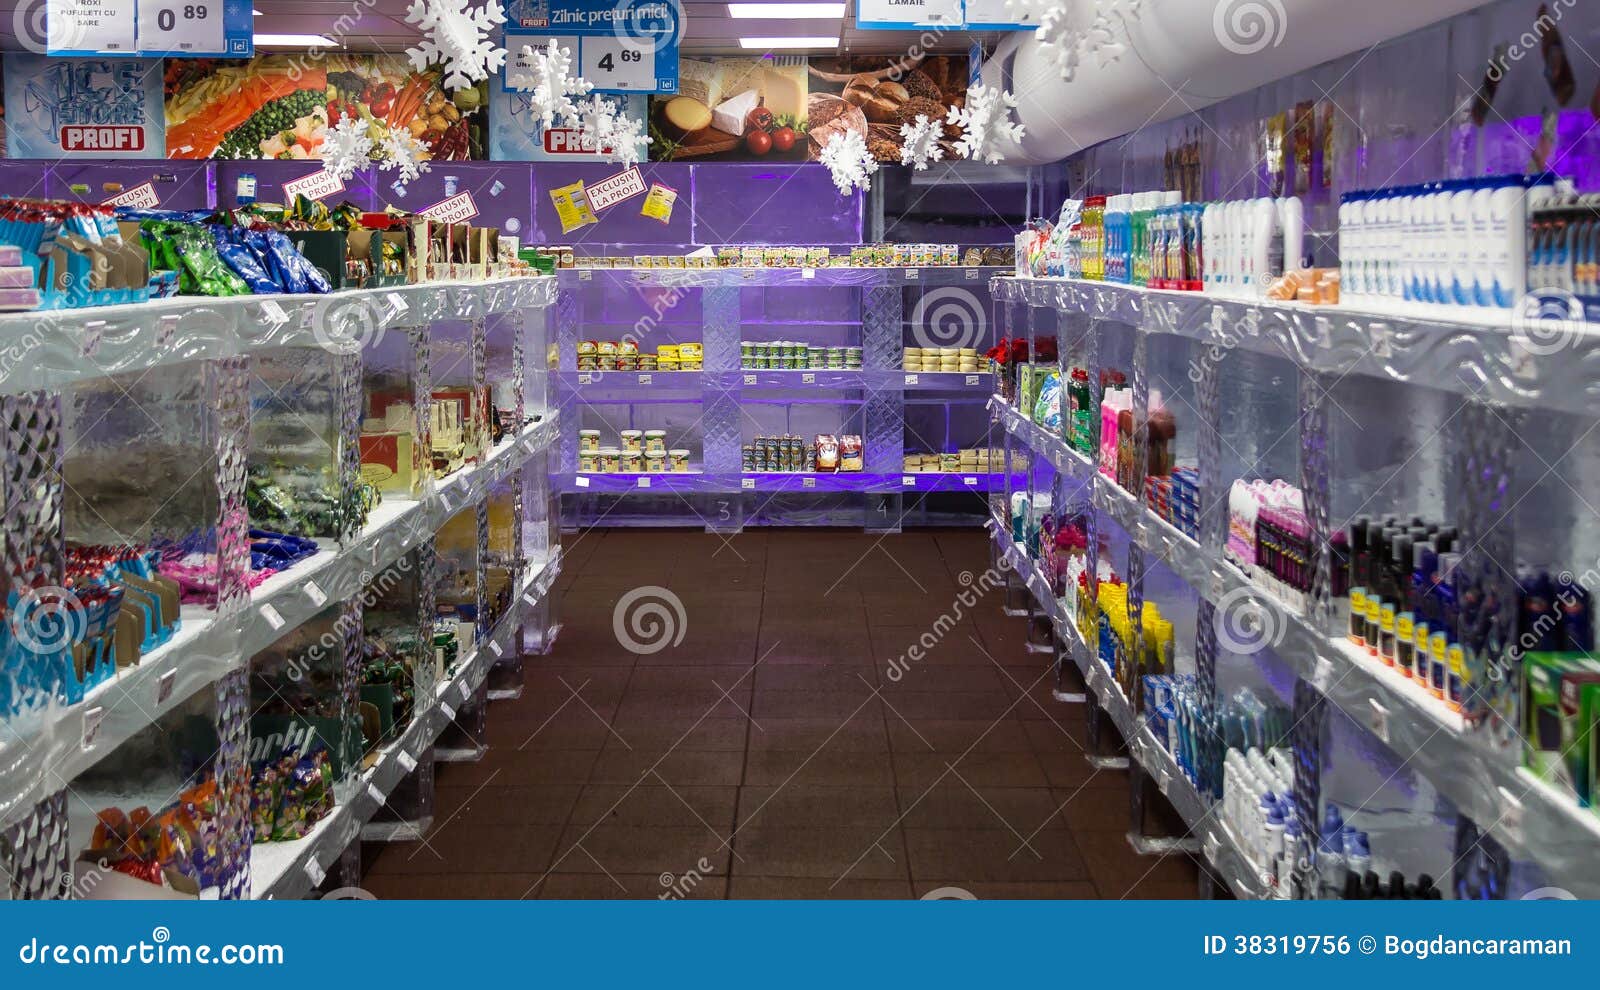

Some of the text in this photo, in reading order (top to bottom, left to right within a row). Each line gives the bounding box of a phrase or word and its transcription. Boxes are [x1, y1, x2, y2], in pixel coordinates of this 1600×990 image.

[158, 5, 208, 32] 0 89
[552, 9, 587, 24] Zilnic
[637, 3, 668, 19] mici!
[233, 40, 245, 50] lei
[598, 50, 642, 73] 4 69
[661, 80, 673, 89] lei
[67, 128, 139, 148] PROFI
[308, 182, 338, 198] PROFI
[590, 172, 635, 197] EXCLUSIV
[596, 182, 639, 207] LA PROFI
[441, 206, 471, 223] PROFI
[717, 501, 730, 521] 3
[876, 499, 888, 519] 4
